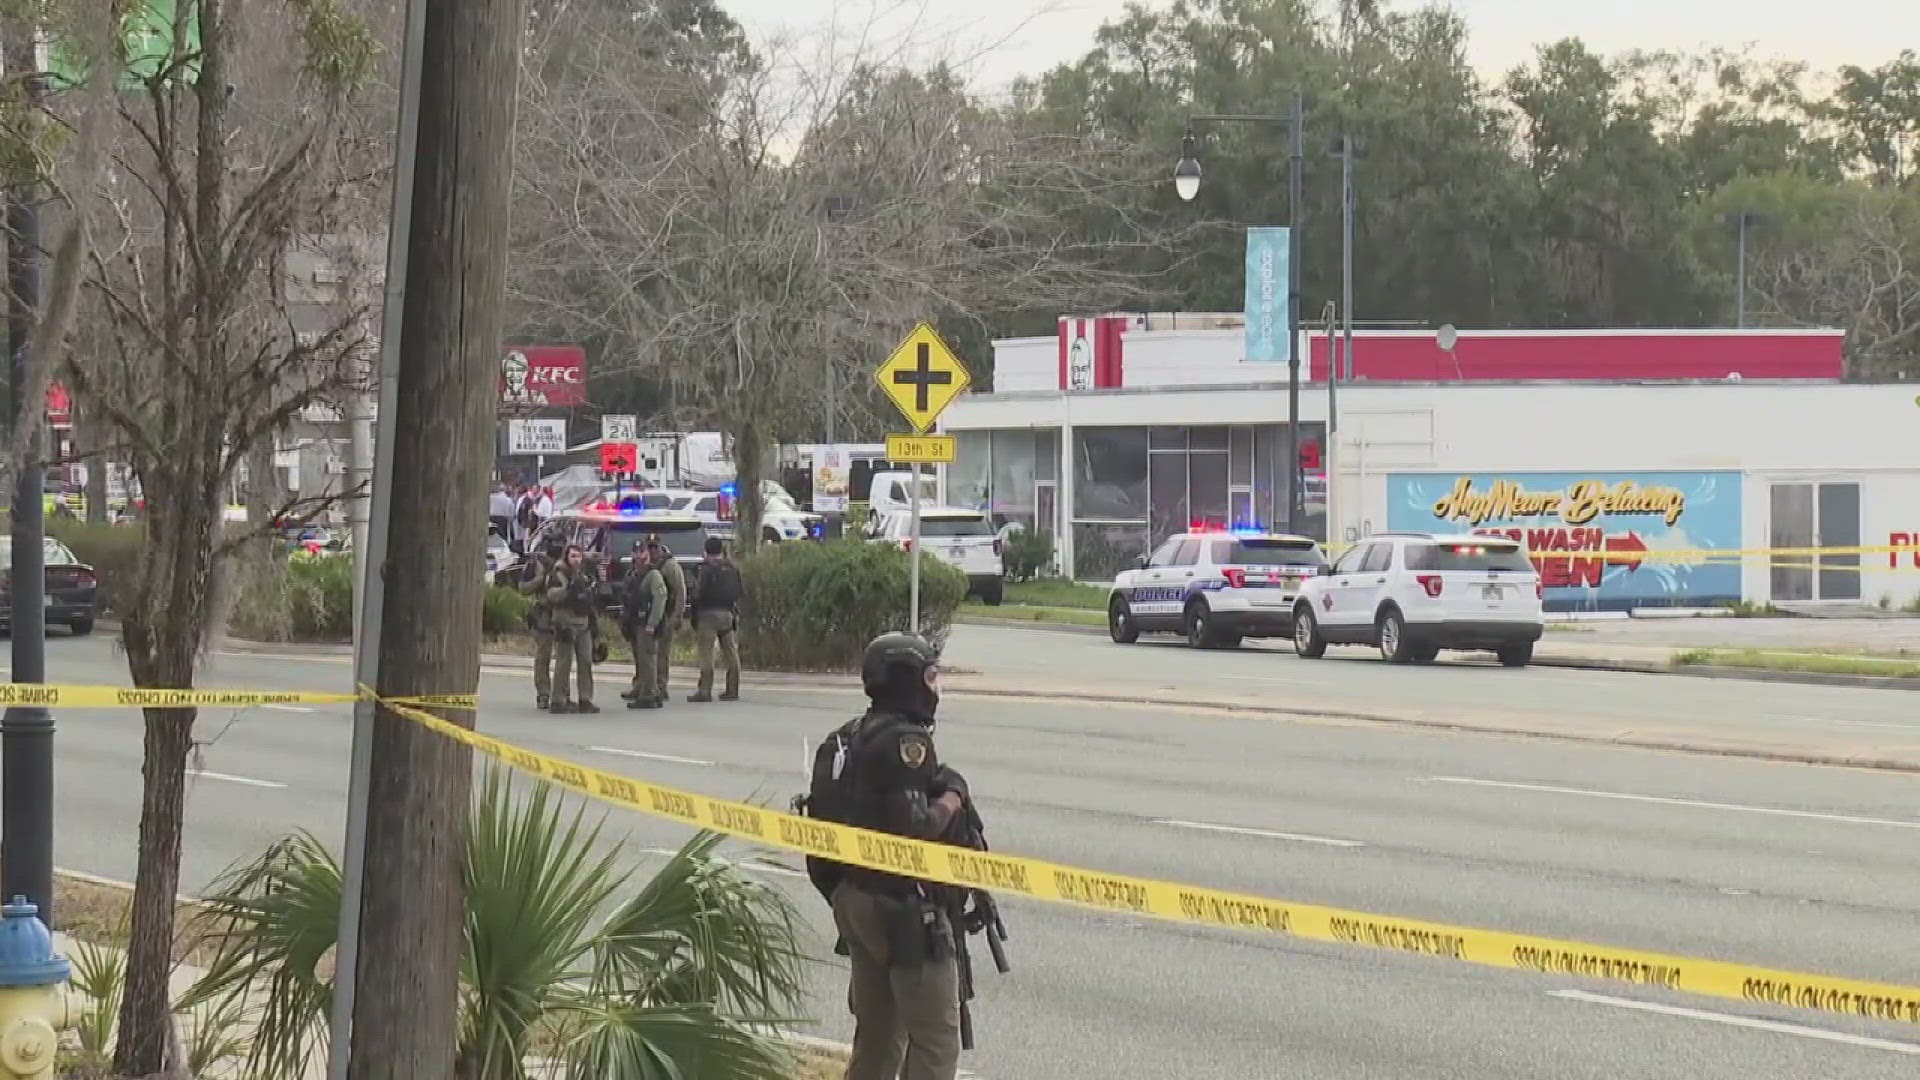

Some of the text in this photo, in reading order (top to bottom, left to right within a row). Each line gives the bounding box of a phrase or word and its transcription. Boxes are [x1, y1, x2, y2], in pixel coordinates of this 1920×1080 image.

[532, 366, 580, 384] KFC
[609, 424, 630, 438] 24
[897, 442, 943, 457] 13th St
[1527, 527, 1603, 551] WASH
[1530, 553, 1603, 588] EN
[18, 687, 60, 706] CRIME
[164, 692, 191, 704] NOT
